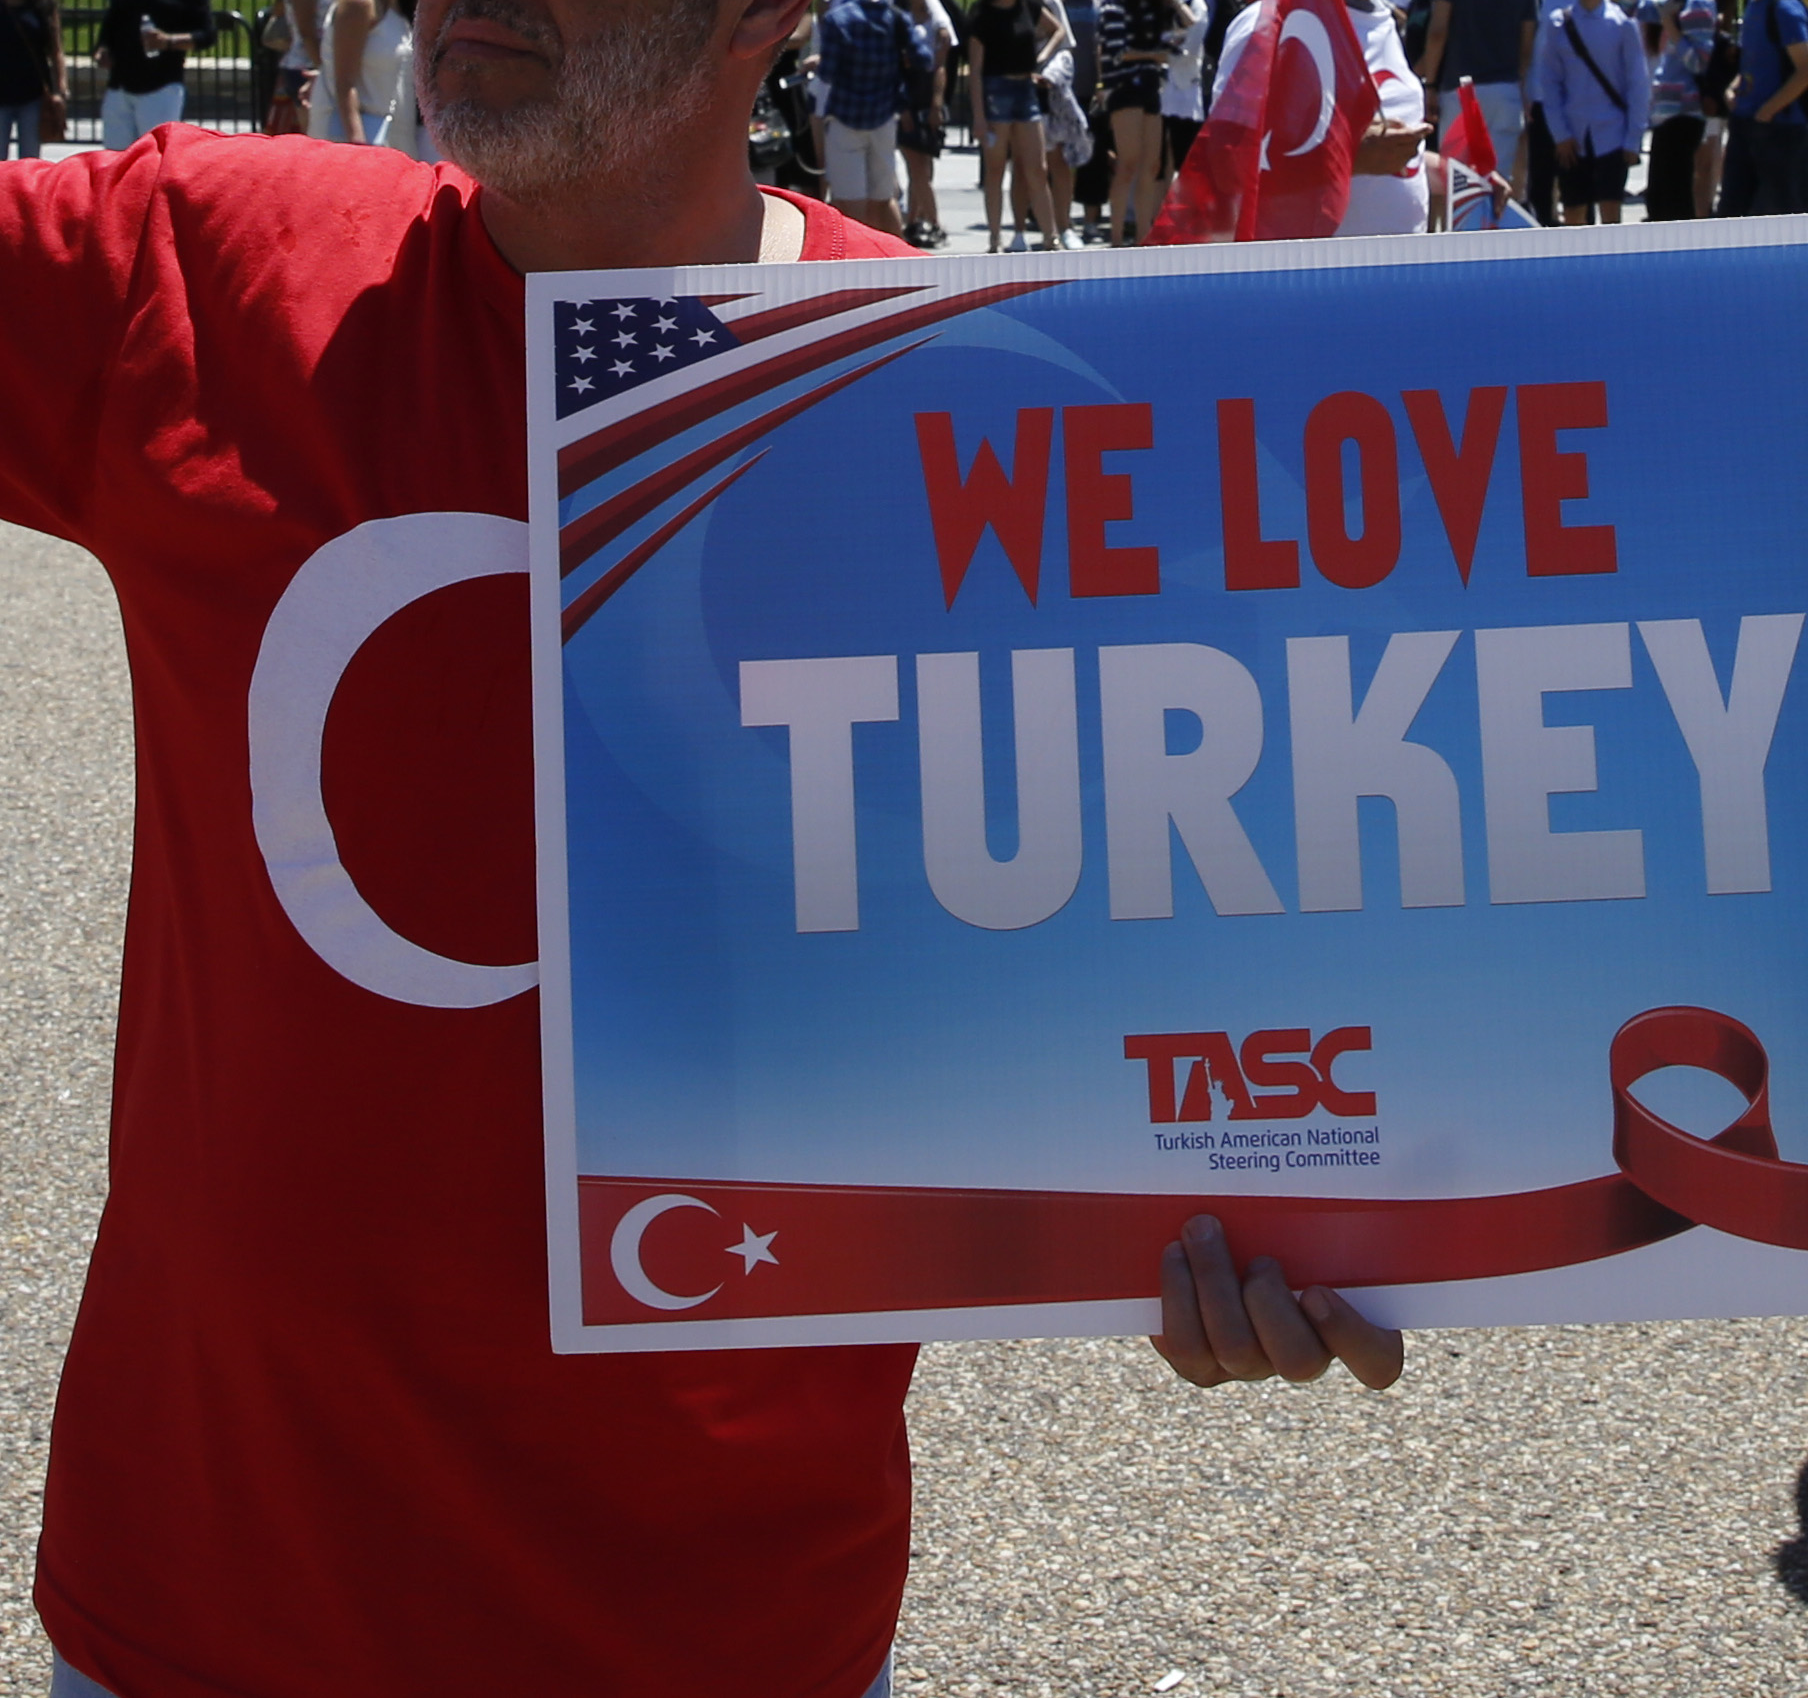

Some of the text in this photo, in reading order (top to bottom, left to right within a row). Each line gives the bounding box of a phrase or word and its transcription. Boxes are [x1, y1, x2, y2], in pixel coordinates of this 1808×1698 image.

[914, 381, 1618, 613] WE LOVE
[739, 612, 1807, 934] TURKEY
[1123, 1025, 1377, 1123] TASC
[1154, 1126, 1379, 1150] Turkish American National
[1209, 1149, 1381, 1172] Steering Committee
